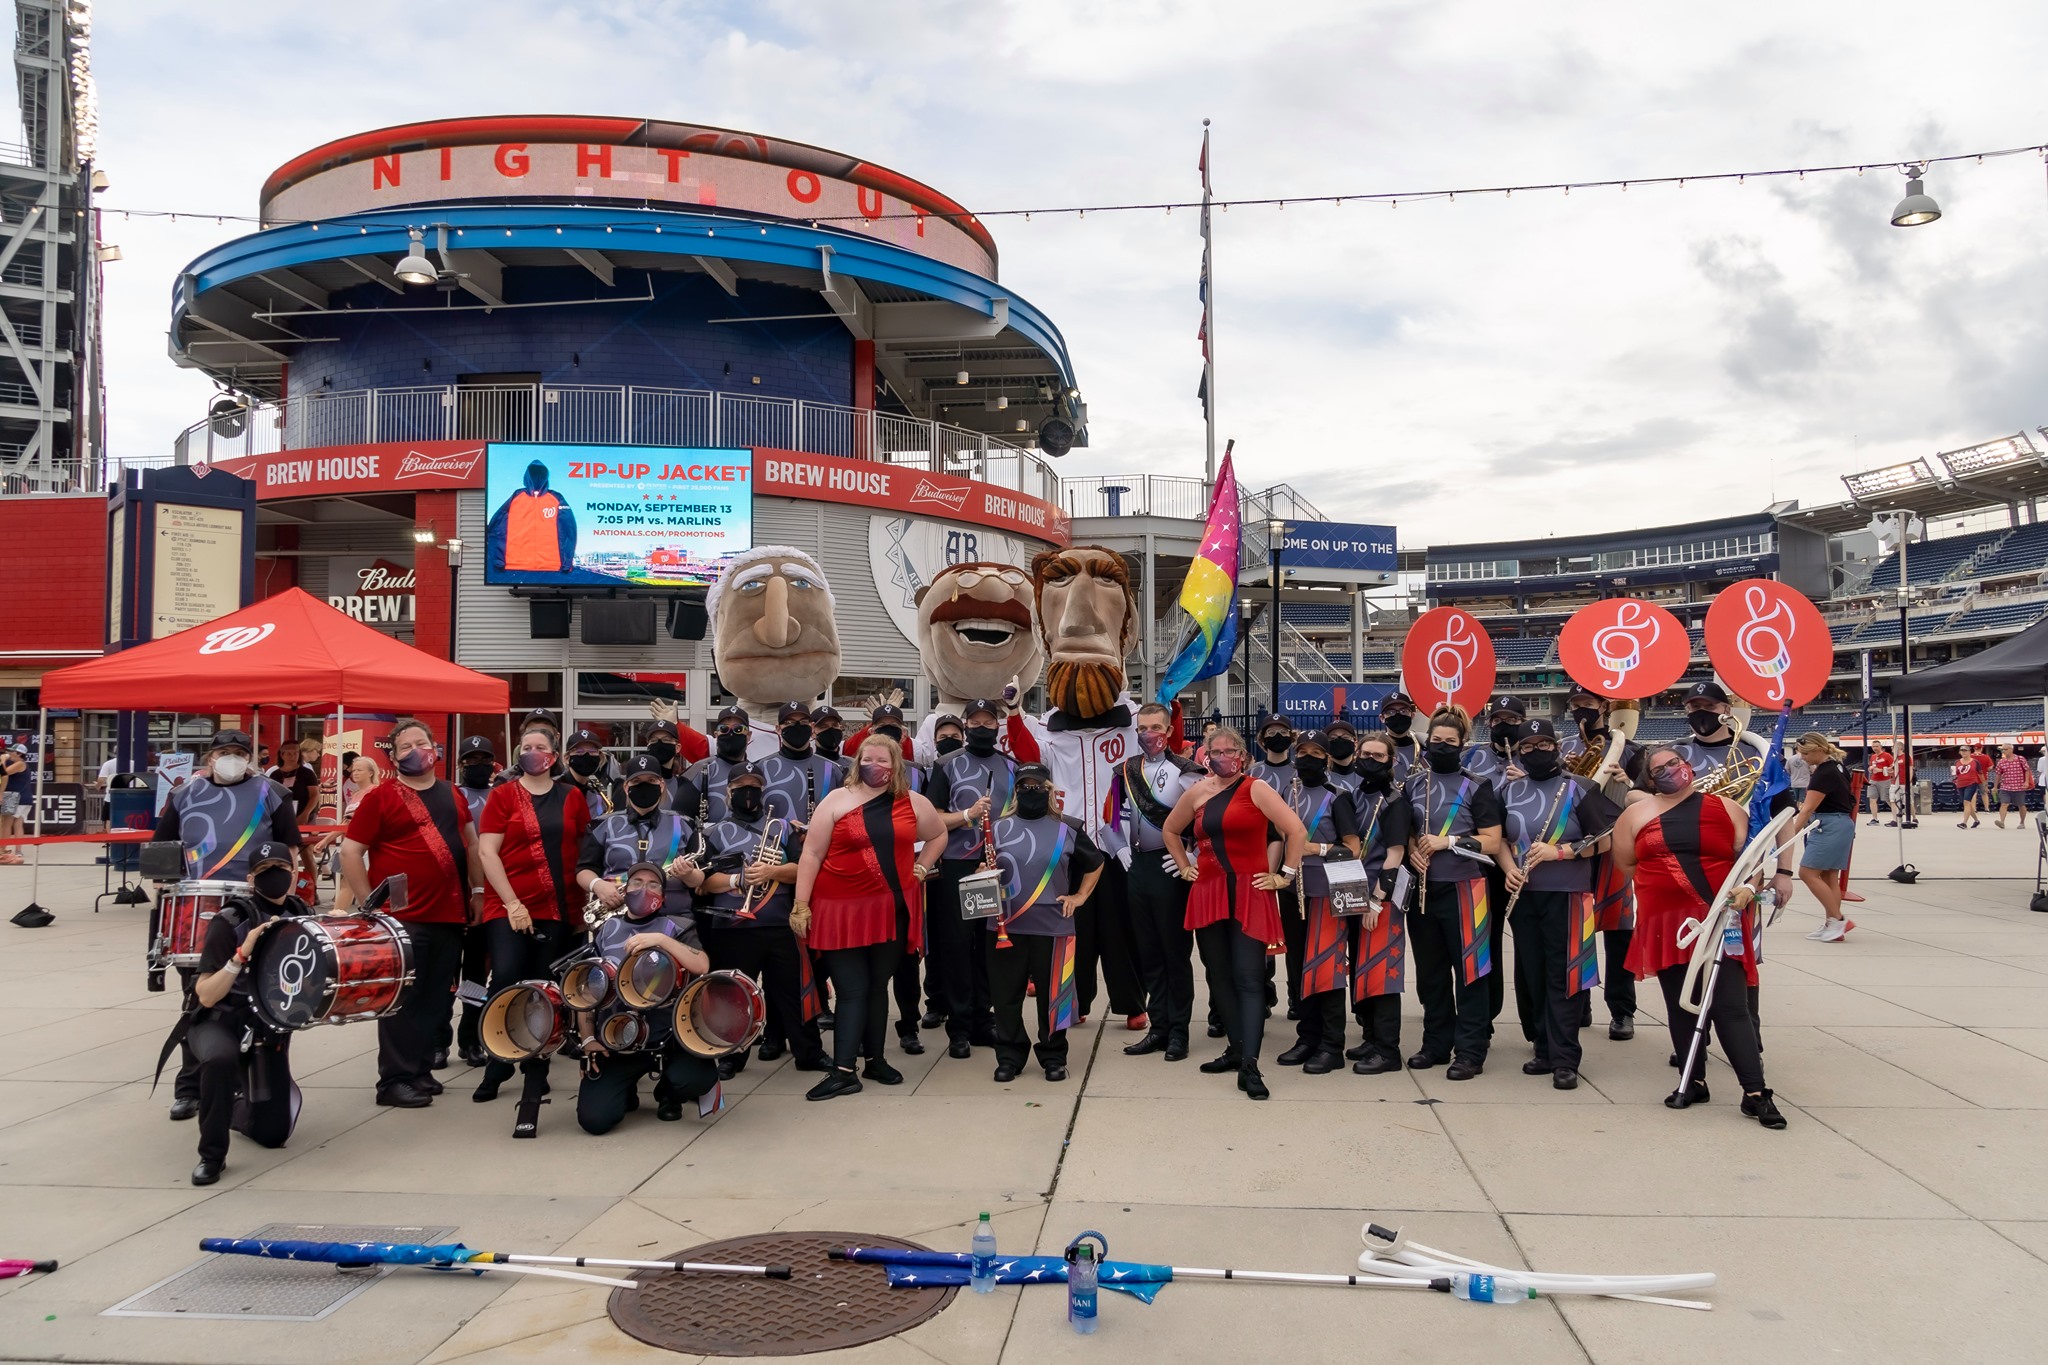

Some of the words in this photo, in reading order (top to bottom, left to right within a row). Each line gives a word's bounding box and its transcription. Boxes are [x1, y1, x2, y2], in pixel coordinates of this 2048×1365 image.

[373, 142, 691, 190] NIGHT
[786, 168, 929, 238] OUT
[266, 459, 313, 486] BREW
[317, 455, 380, 481] HOUSE
[401, 456, 474, 472] Budweiser
[568, 462, 650, 480] ZIP-UP
[657, 464, 750, 482] JACKET
[764, 460, 825, 487] BREW
[828, 467, 891, 496] HOUSE
[916, 480, 966, 504] Budweiser
[586, 502, 642, 513] MONDAY,
[644, 504, 716, 513] SEPTEMBER
[720, 504, 732, 514] 13
[984, 493, 1016, 520] BREW
[1018, 502, 1046, 529] HOUSE
[597, 515, 624, 524] 7:05
[626, 516, 644, 524] PM
[648, 517, 664, 525] vs.
[667, 516, 722, 526] MARLINS
[593, 530, 726, 538] NATIONALS.COM/PROMOTIONS
[1282, 538, 1308, 550] OME
[1311, 540, 1330, 550] ON
[1332, 540, 1348, 552] UP
[1351, 542, 1368, 553] TO
[1370, 542, 1394, 554] THE
[1285, 700, 1327, 711] ULTRA
[1352, 700, 1382, 711] LOF
[1939, 736, 1997, 745] NIGHT
[2016, 736, 2039, 744] OU
[1072, 1296, 1090, 1307] SANI
